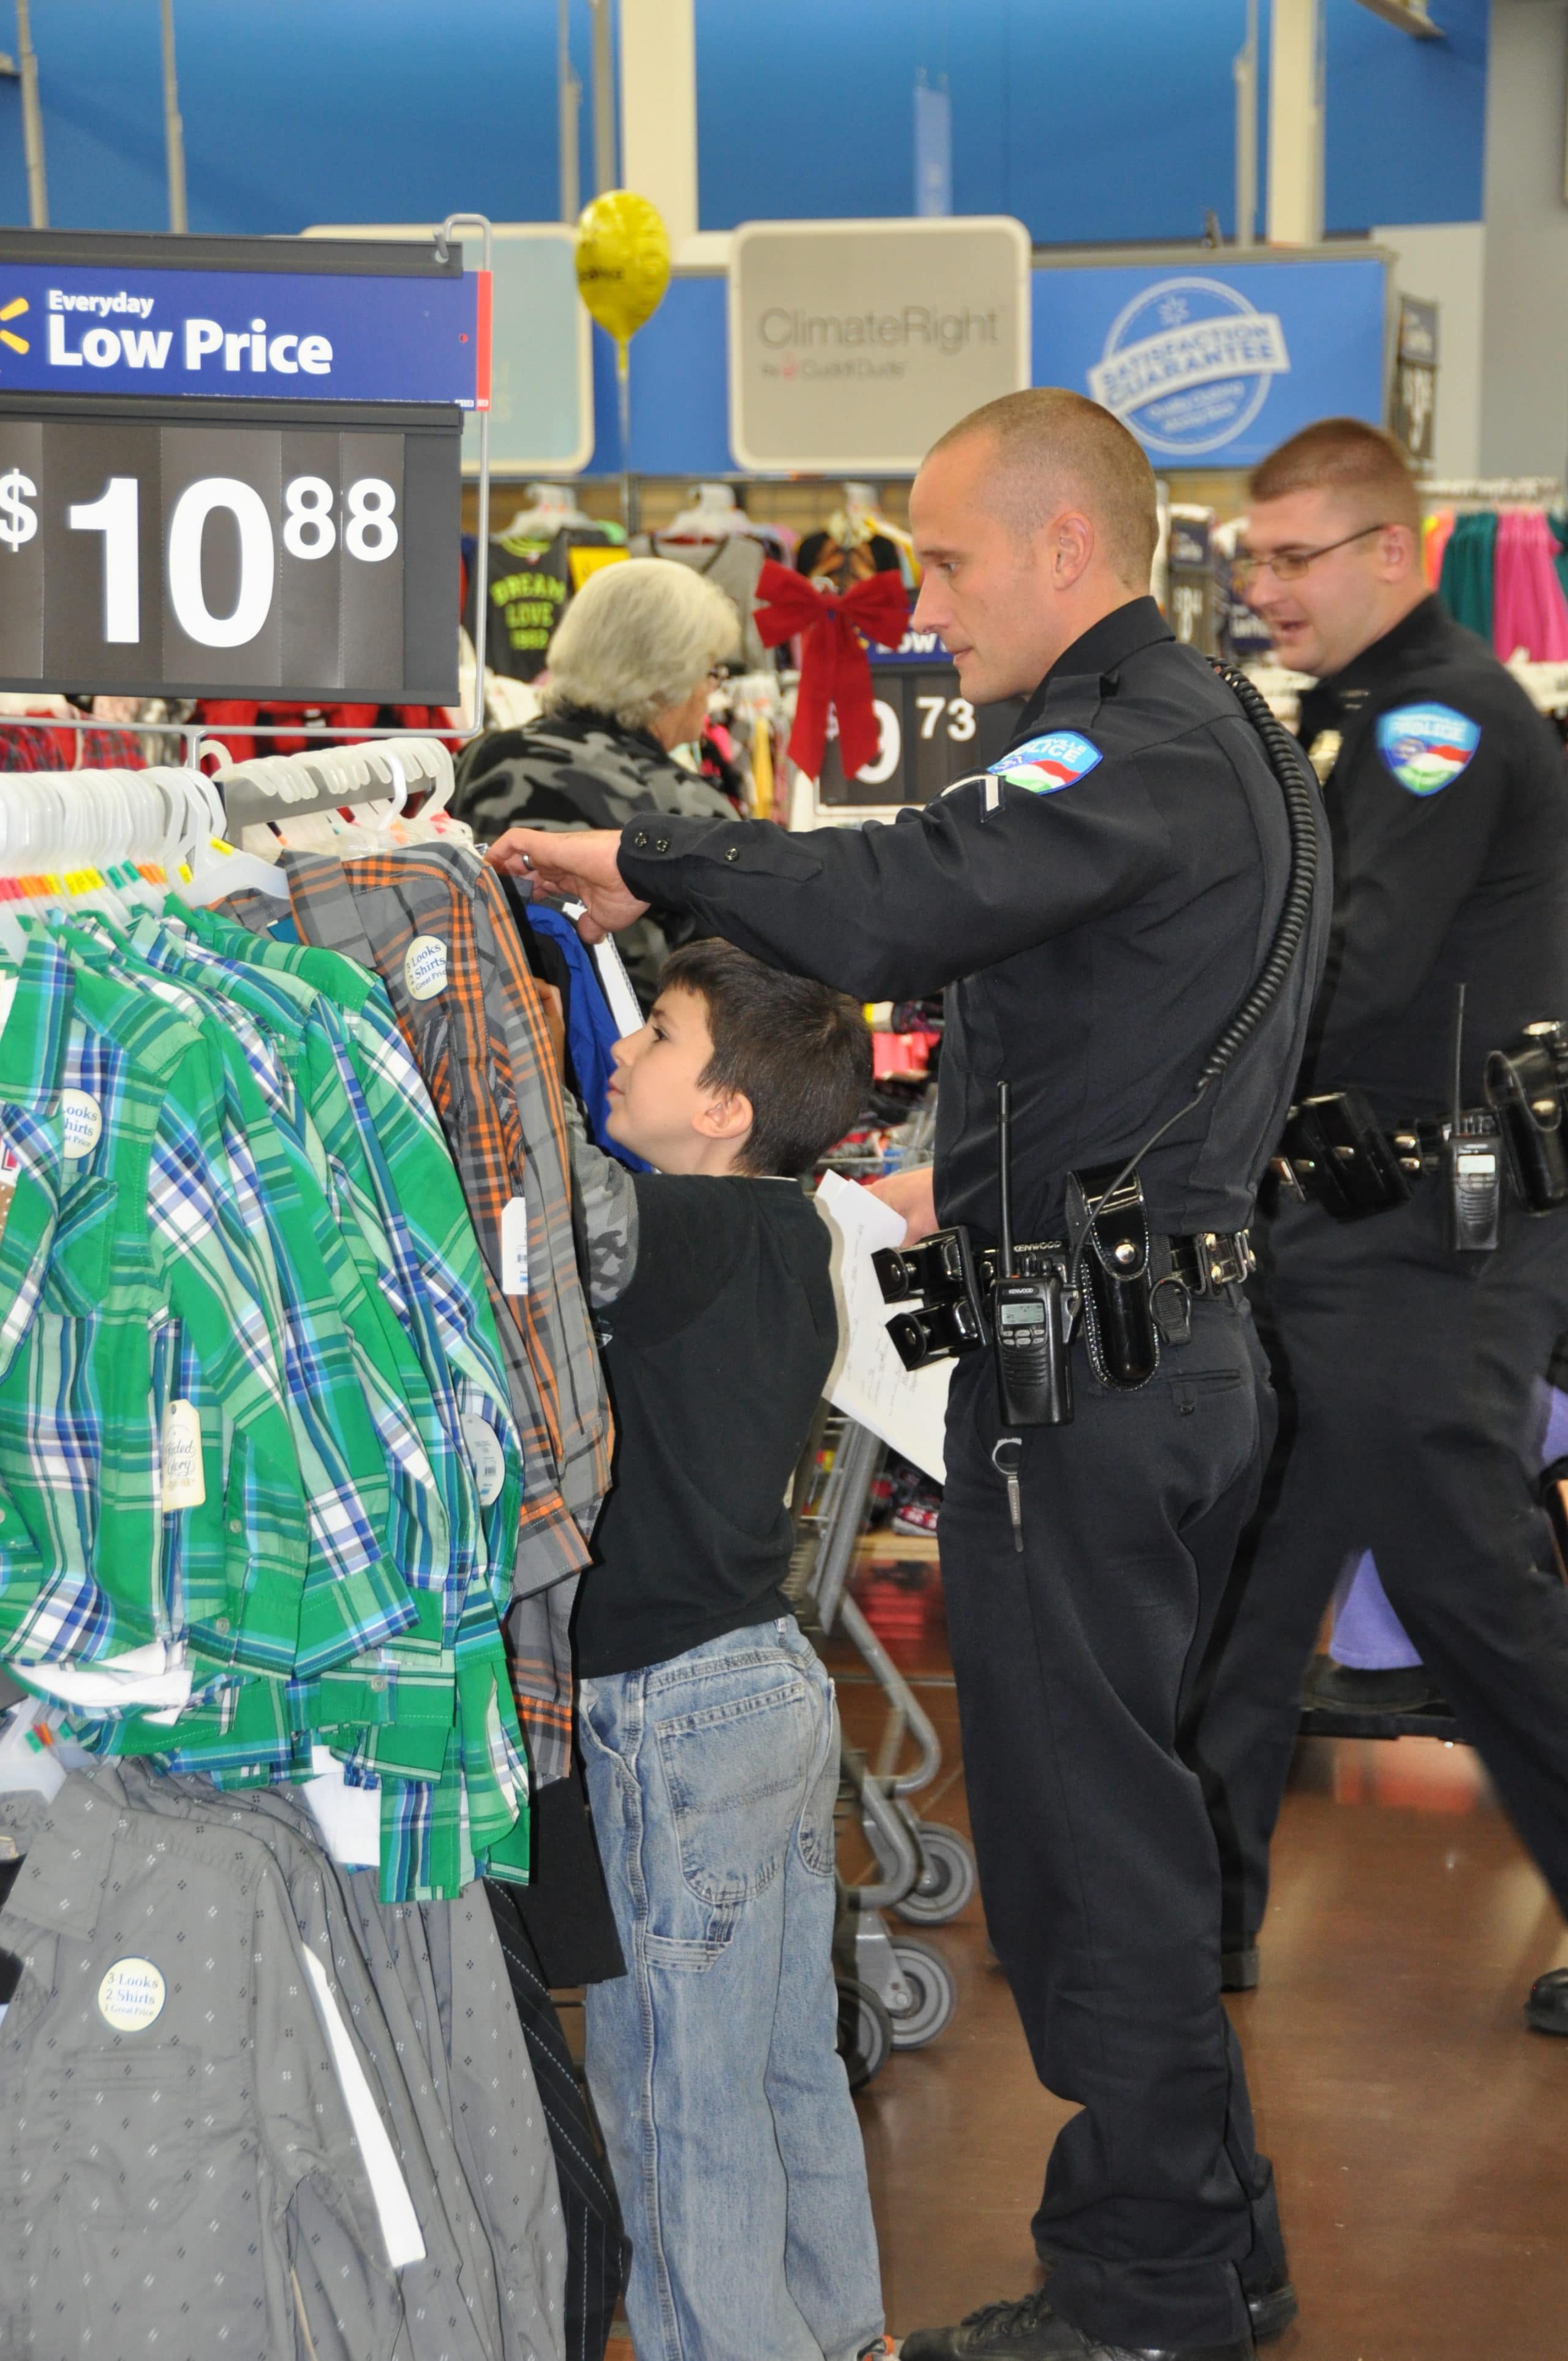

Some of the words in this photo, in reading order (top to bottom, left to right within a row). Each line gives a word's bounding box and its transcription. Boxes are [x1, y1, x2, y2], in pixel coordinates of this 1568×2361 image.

[48, 290, 154, 319] Everyday
[758, 306, 1000, 356] ClimateRight
[48, 314, 173, 369] Low
[185, 319, 334, 374] Price
[412, 944, 441, 967] Looks
[415, 957, 446, 980] Shirts
[432, 970, 447, 980] Pric
[63, 1106, 97, 1121] ooks
[64, 1119, 93, 1135] hirts
[73, 1136, 91, 1147] Price
[1014, 1241, 1062, 1252] KENWOOD
[108, 1972, 115, 1984] 3
[119, 1973, 158, 1989] Looks
[106, 1989, 113, 2000] 2
[118, 1989, 155, 2004] Shirts
